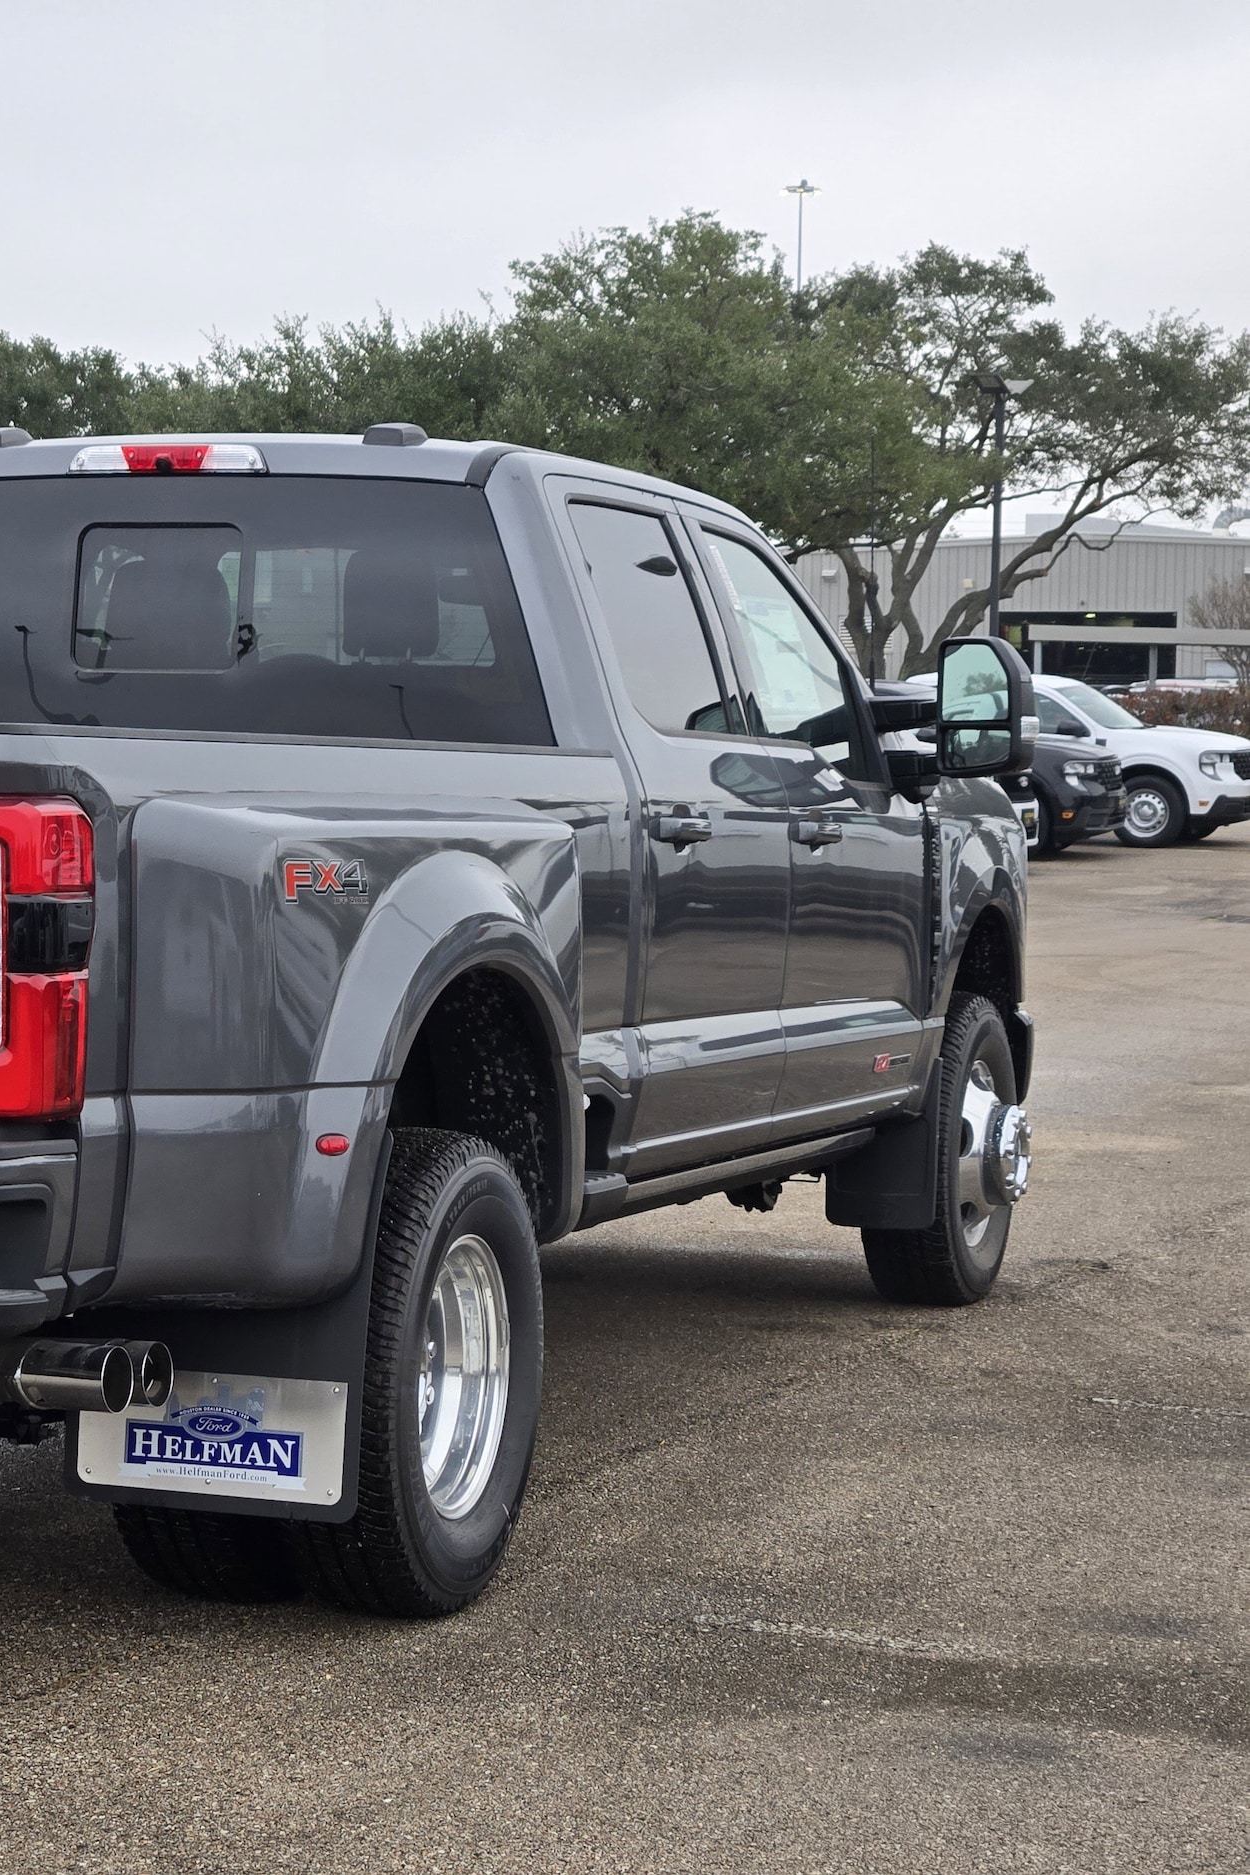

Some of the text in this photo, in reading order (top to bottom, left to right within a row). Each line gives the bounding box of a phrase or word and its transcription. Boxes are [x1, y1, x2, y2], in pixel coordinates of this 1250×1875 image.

[283, 858, 368, 904] FX4
[179, 1407, 203, 1415] HOUSTON
[223, 1407, 237, 1416] SINCE
[195, 1416, 234, 1433] Ford
[131, 1427, 296, 1469] HELFMAN
[156, 1465, 268, 1483] www.HelfmanFord.com
